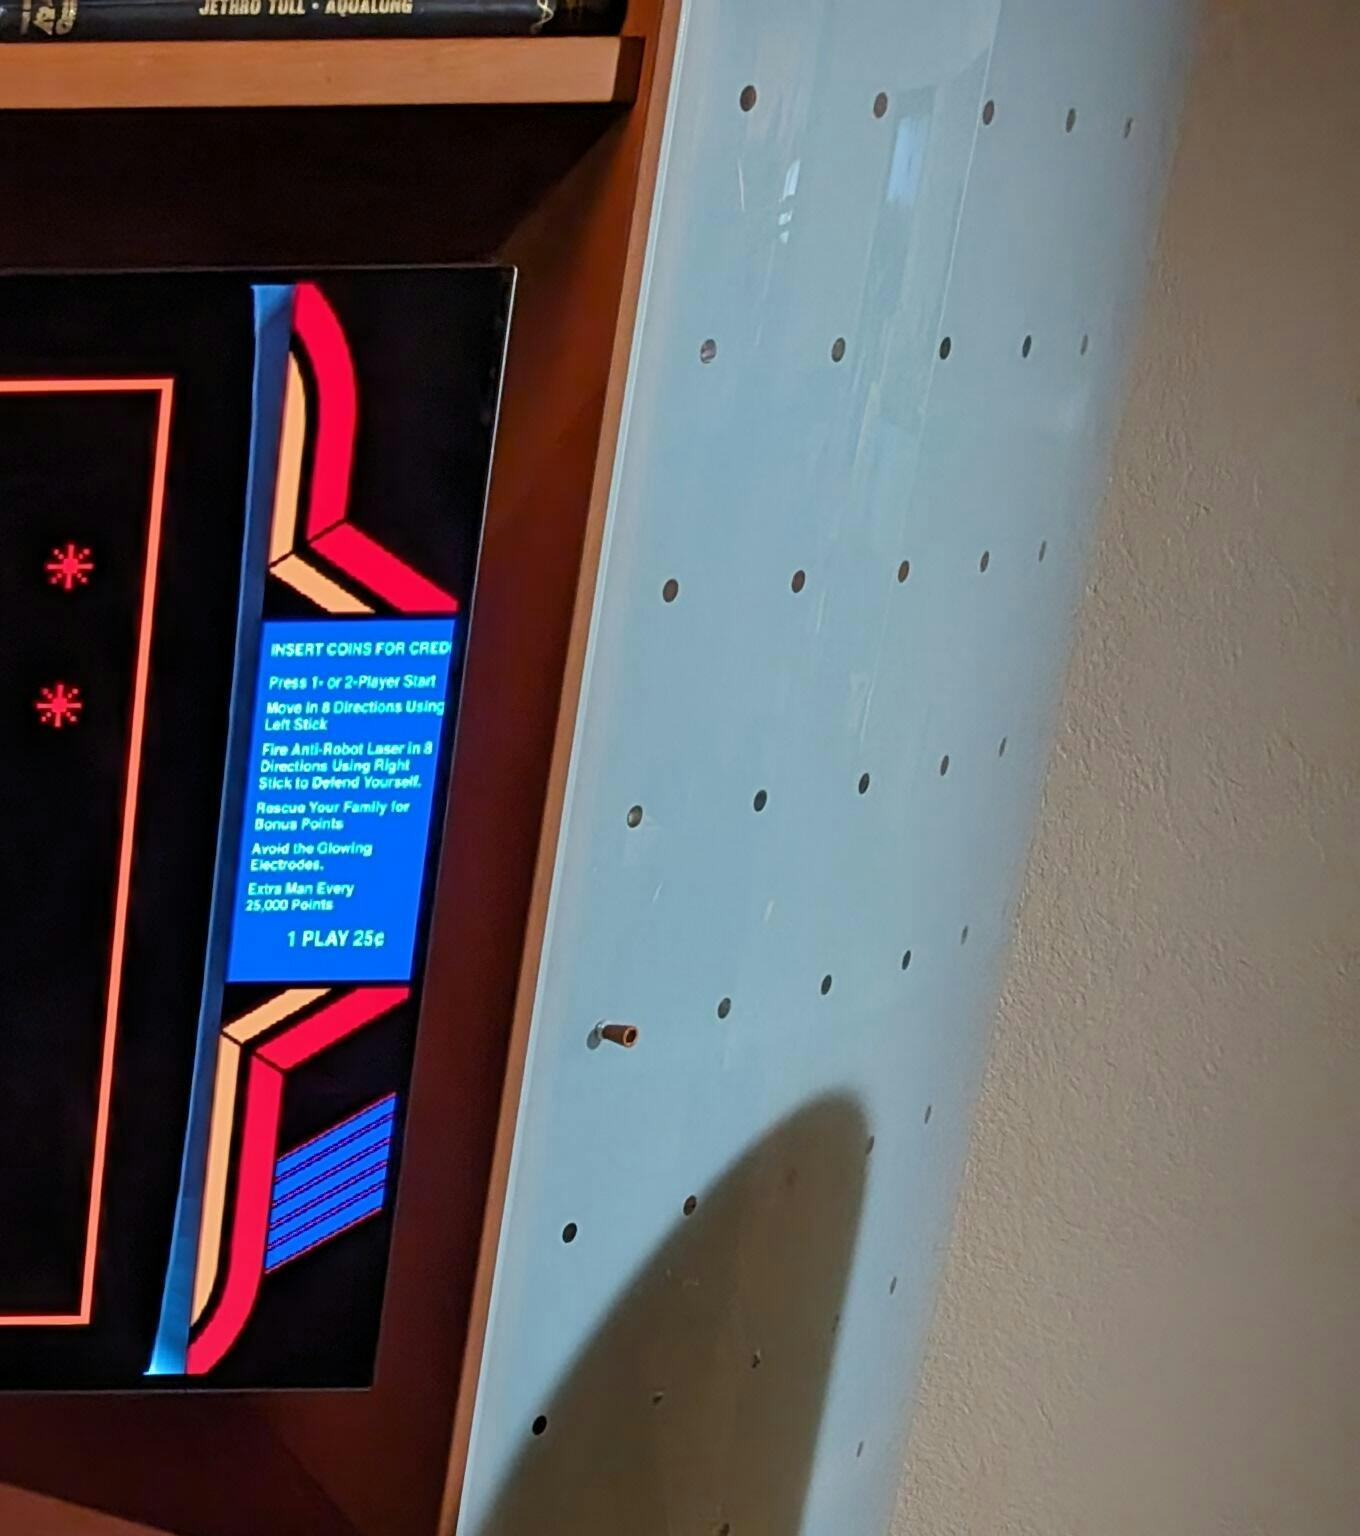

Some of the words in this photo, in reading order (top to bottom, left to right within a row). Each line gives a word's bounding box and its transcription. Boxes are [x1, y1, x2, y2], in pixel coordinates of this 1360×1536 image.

[199, 0, 261, 15] JETHRO
[269, 0, 305, 15] TULL
[325, 0, 413, 17] AQUALUNG
[271, 643, 324, 656] INSERT
[327, 643, 372, 656] COINS
[375, 642, 405, 656] FOR
[269, 676, 307, 689] Press
[312, 676, 324, 689] 1-
[327, 678, 341, 688] or
[345, 675, 400, 691] 2-Player
[403, 675, 436, 688] Start
[267, 702, 302, 714] Move
[306, 702, 318, 714] in
[322, 702, 330, 713] 8
[334, 701, 402, 714] Directions
[406, 700, 445, 716] Using
[265, 719, 290, 731] Left
[293, 718, 328, 730] Stick
[262, 743, 288, 756] Fire
[291, 742, 363, 756] Anti-Robot
[367, 742, 406, 755] Laser
[407, 742, 421, 754] in
[261, 760, 328, 772] Directions
[332, 759, 371, 774] Using
[374, 759, 410, 774] Right
[259, 777, 292, 790] Stick
[295, 778, 308, 789] to
[312, 777, 360, 789] Defend
[364, 775, 422, 789] Yourself.
[256, 802, 306, 814] Rescue
[309, 802, 340, 813] Your
[343, 801, 388, 816] Family
[391, 801, 410, 812] for
[255, 819, 297, 831] Bonus
[301, 818, 344, 830] Points
[252, 843, 290, 855] Avoid
[293, 843, 314, 854] the
[317, 842, 373, 856] Glowing
[250, 859, 324, 872] Electrodes.
[248, 883, 282, 895] Extra
[285, 882, 313, 895] Man
[317, 882, 354, 897] Every
[245, 900, 288, 913] 25,000
[291, 899, 333, 911] Points
[288, 931, 295, 947] 1
[302, 931, 349, 947] PLAY
